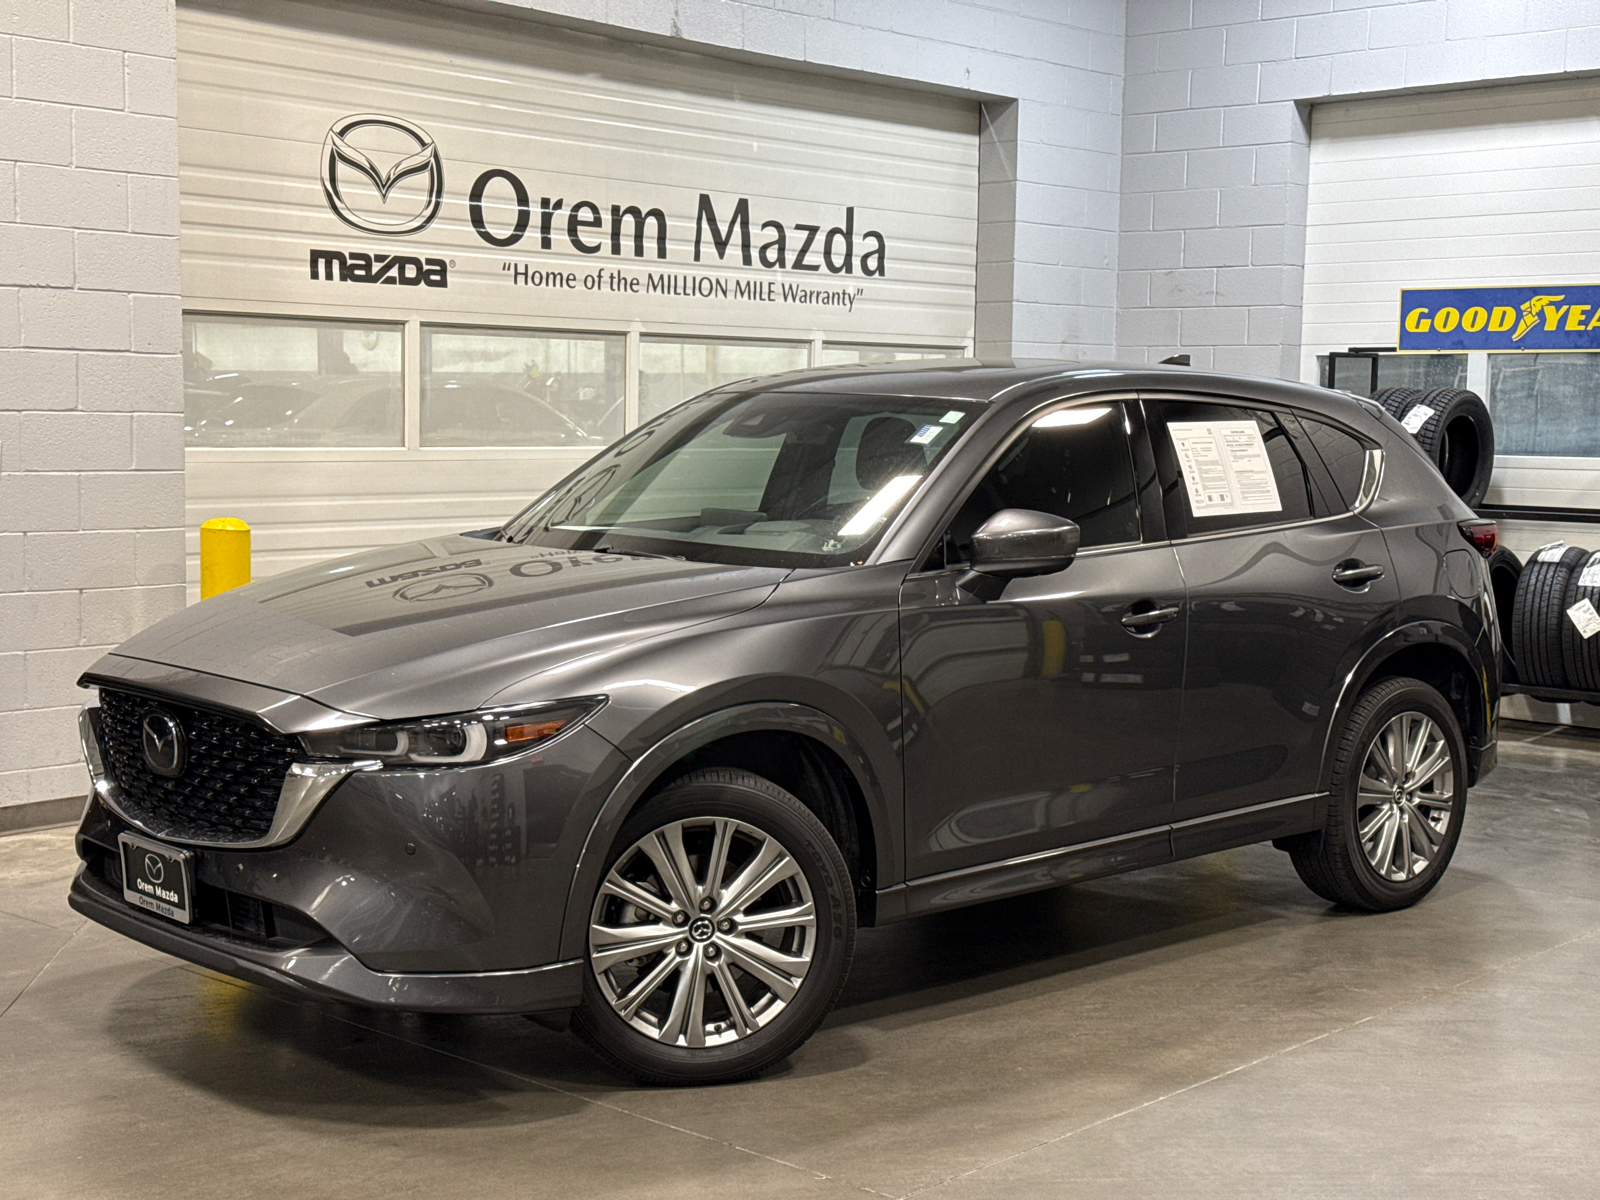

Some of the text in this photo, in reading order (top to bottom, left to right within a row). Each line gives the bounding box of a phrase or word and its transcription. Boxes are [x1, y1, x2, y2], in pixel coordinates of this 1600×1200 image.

[468, 168, 887, 278] Orem Mazda
[583, 267, 605, 290] of
[609, 268, 641, 293] the
[646, 275, 728, 299] MILLION
[733, 280, 777, 302] MILE
[137, 878, 178, 903] Orem Mazda
